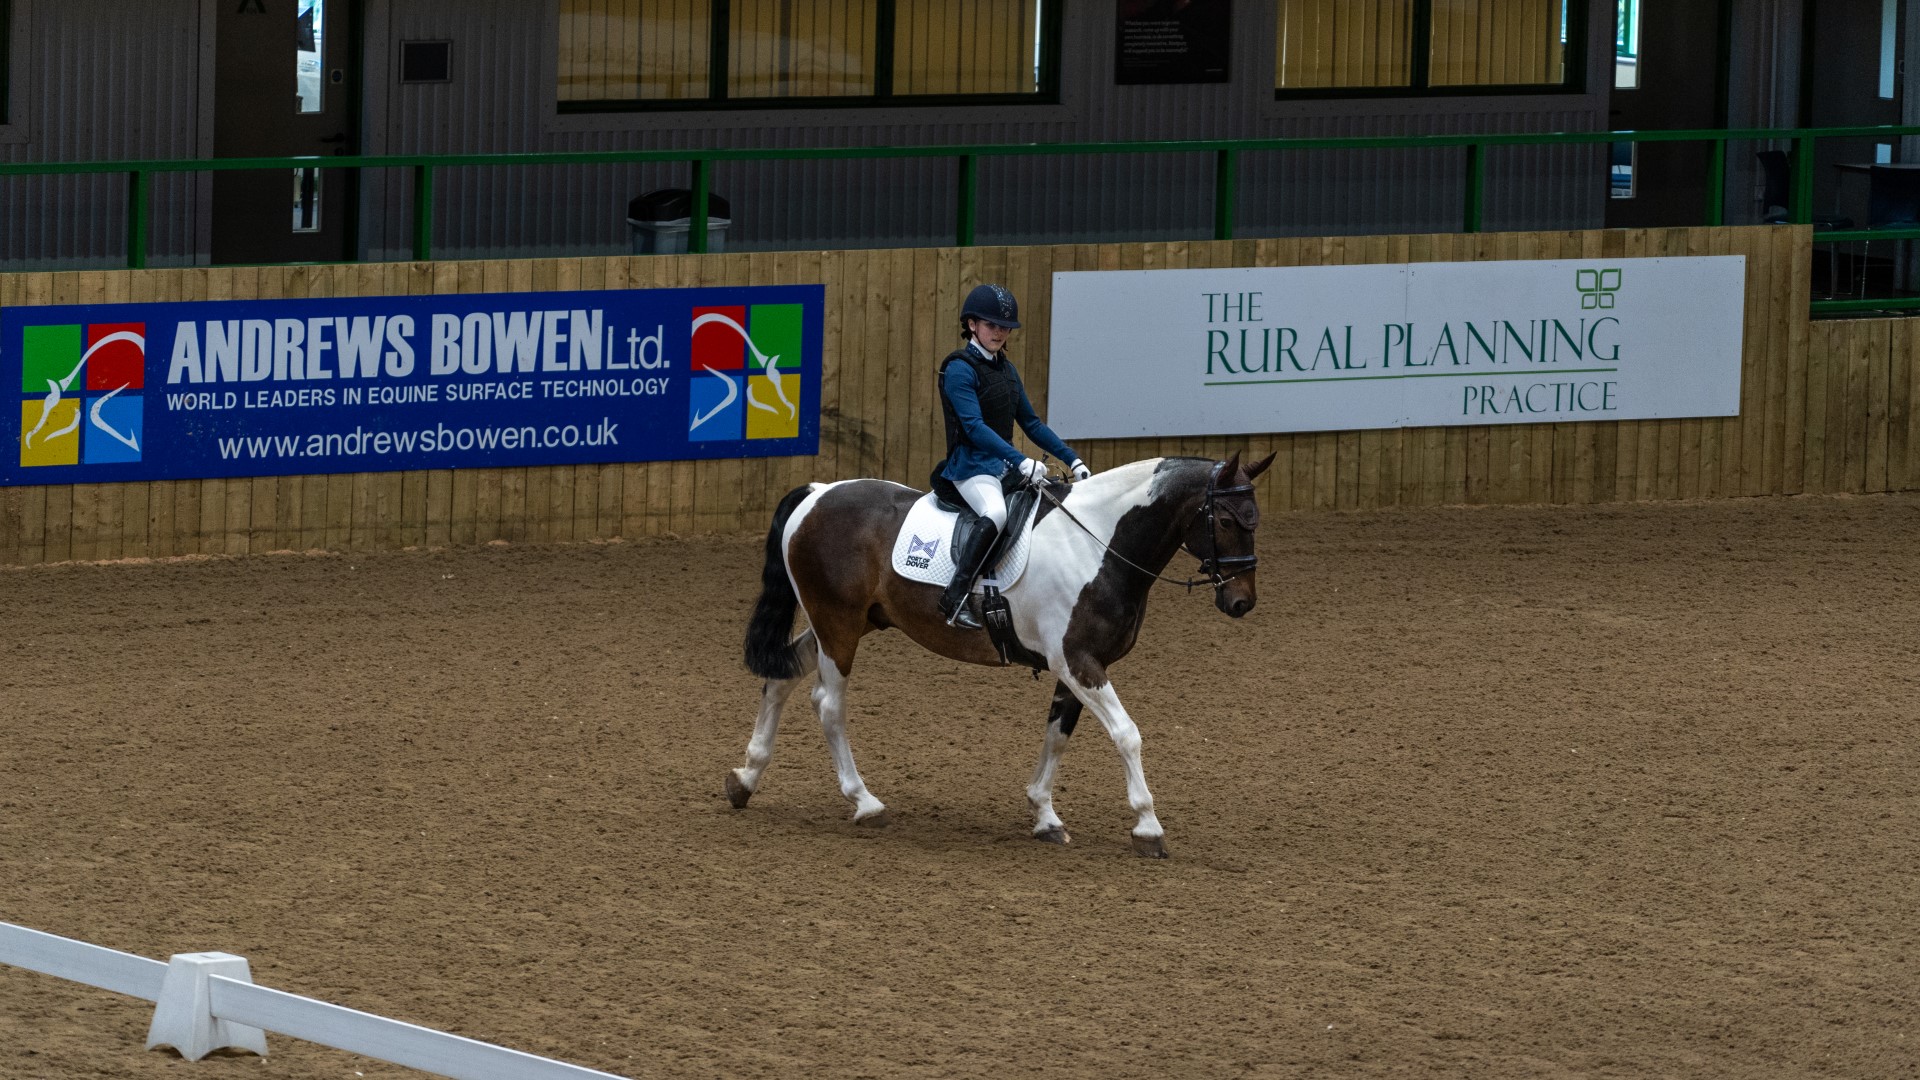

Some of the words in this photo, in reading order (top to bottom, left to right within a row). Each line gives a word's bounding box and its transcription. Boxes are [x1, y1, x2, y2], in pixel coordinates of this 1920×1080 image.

[1201, 292, 1263, 323] THE
[166, 314, 415, 384] ANDREWS
[430, 309, 603, 376] BOWEN
[606, 324, 670, 370] Ltd.
[1206, 325, 1367, 375] RURAL
[1382, 316, 1620, 368] PLANNING
[166, 391, 237, 411] WORLD
[244, 388, 336, 409] LEADERS
[343, 387, 362, 405] IN
[368, 384, 439, 405] EQUINE
[445, 381, 534, 402] SURFACE
[540, 377, 670, 398] TECHNOLOGY
[1463, 381, 1617, 415] PRACTICE
[218, 416, 618, 460] www.andrewsbowen.co.uk
[906, 560, 928, 569] DOVER
